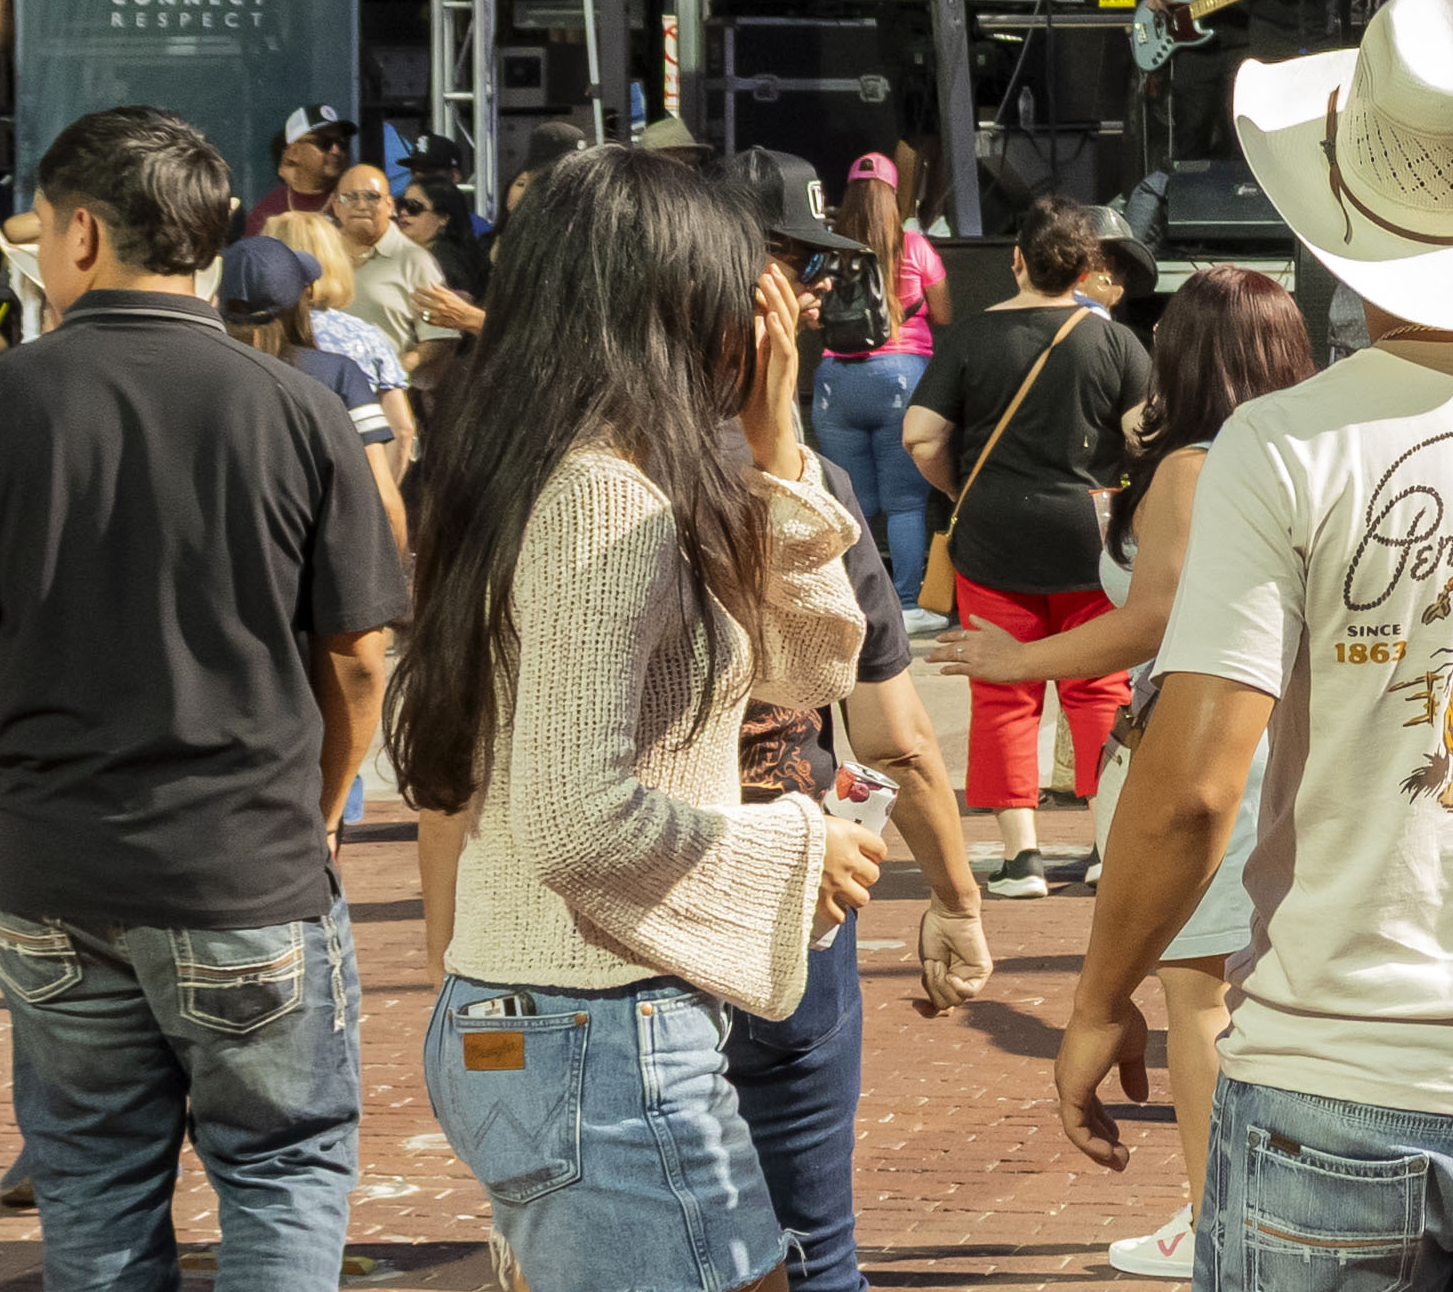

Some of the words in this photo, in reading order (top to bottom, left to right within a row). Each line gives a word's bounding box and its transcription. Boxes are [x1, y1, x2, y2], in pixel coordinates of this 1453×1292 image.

[110, 12, 264, 29] RESPECT
[1347, 623, 1402, 639] SINCE
[1334, 640, 1408, 665] 1863
